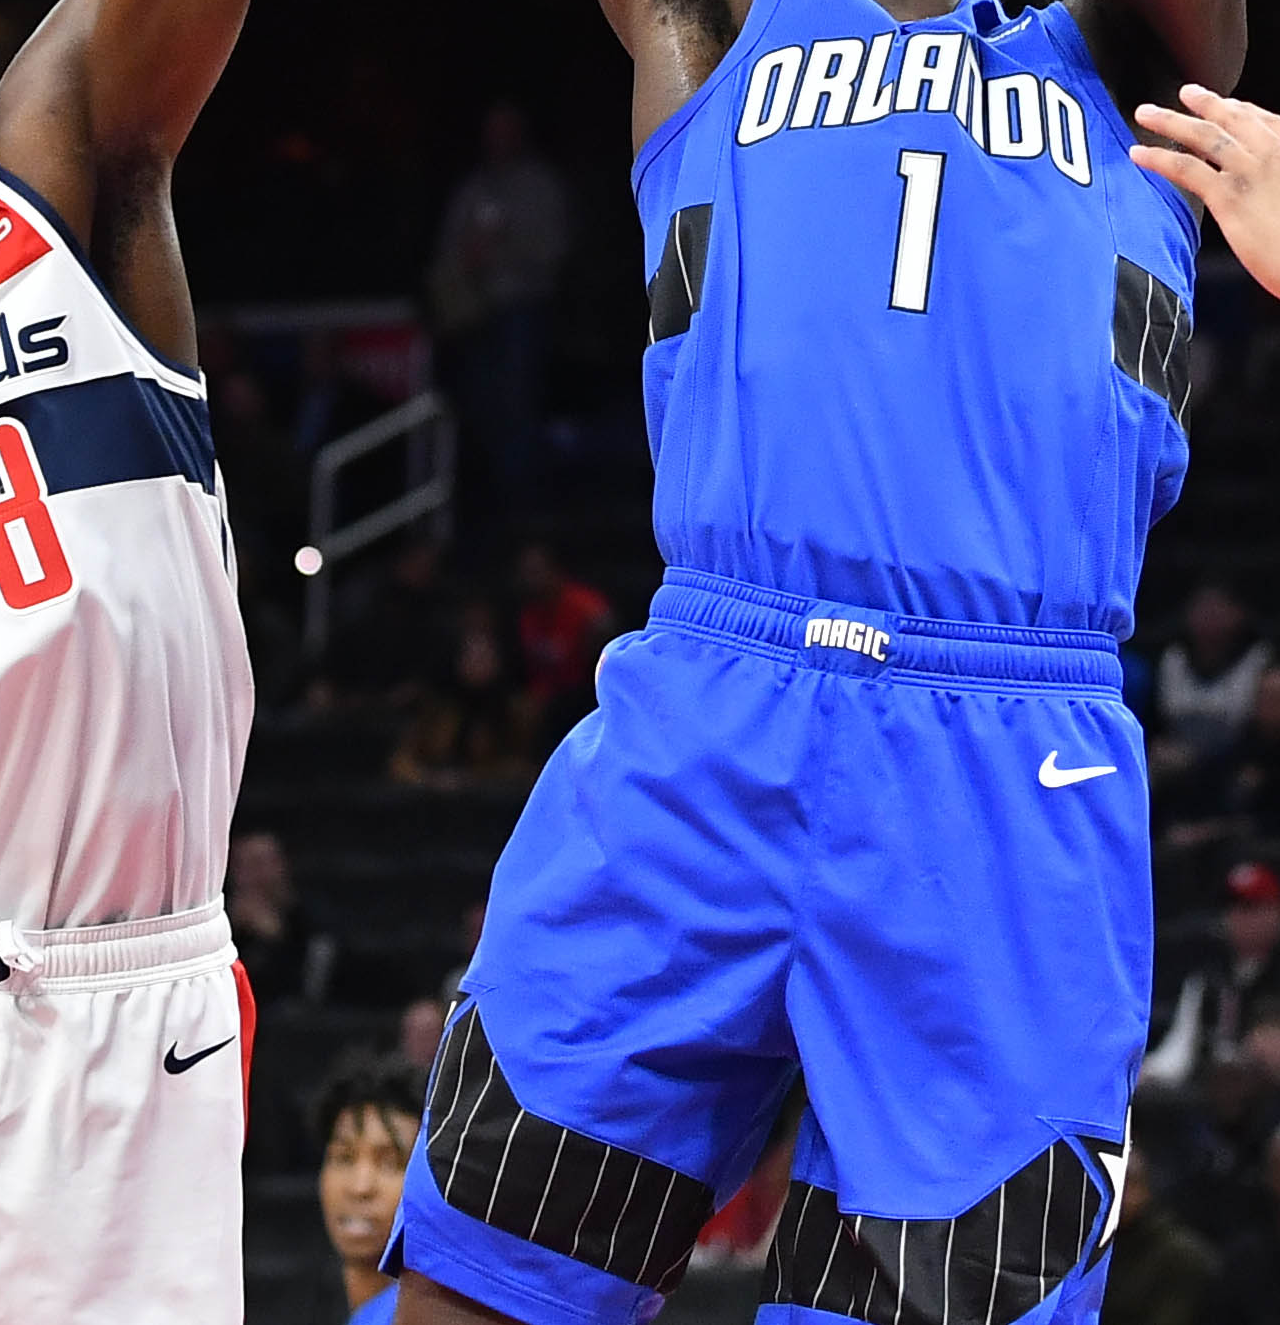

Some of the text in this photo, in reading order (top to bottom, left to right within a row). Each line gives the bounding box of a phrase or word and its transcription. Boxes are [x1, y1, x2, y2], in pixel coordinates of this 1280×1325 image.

[734, 31, 1093, 188] ORLANDO
[887, 148, 947, 315] 1
[804, 618, 890, 662] MAGIC
